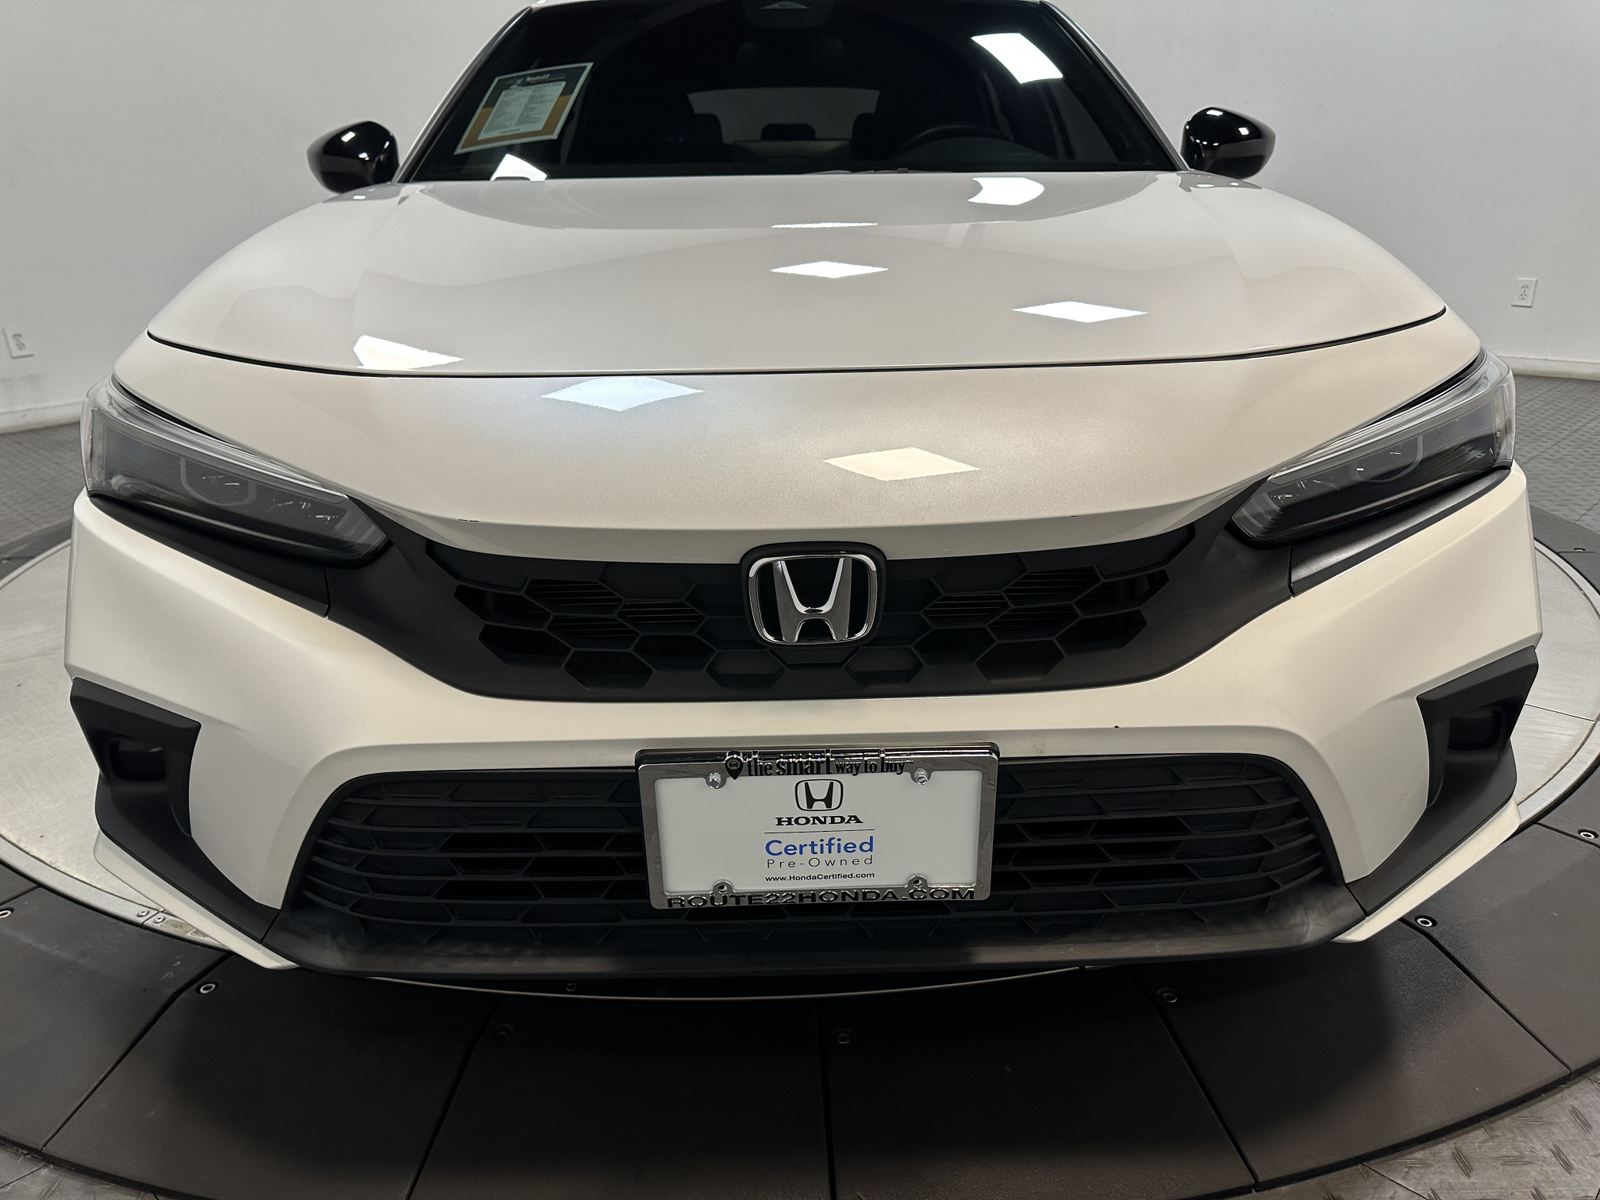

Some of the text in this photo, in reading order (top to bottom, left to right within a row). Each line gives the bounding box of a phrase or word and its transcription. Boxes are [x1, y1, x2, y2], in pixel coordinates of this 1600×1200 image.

[747, 753, 907, 777] the smart way to buy
[775, 815, 863, 826] HONDA
[765, 835, 874, 856] Certified
[767, 855, 873, 868] Pre-Owned
[765, 872, 875, 882] www.HondaCertified.com
[667, 887, 975, 908] ROUTE22HONDA.COM
